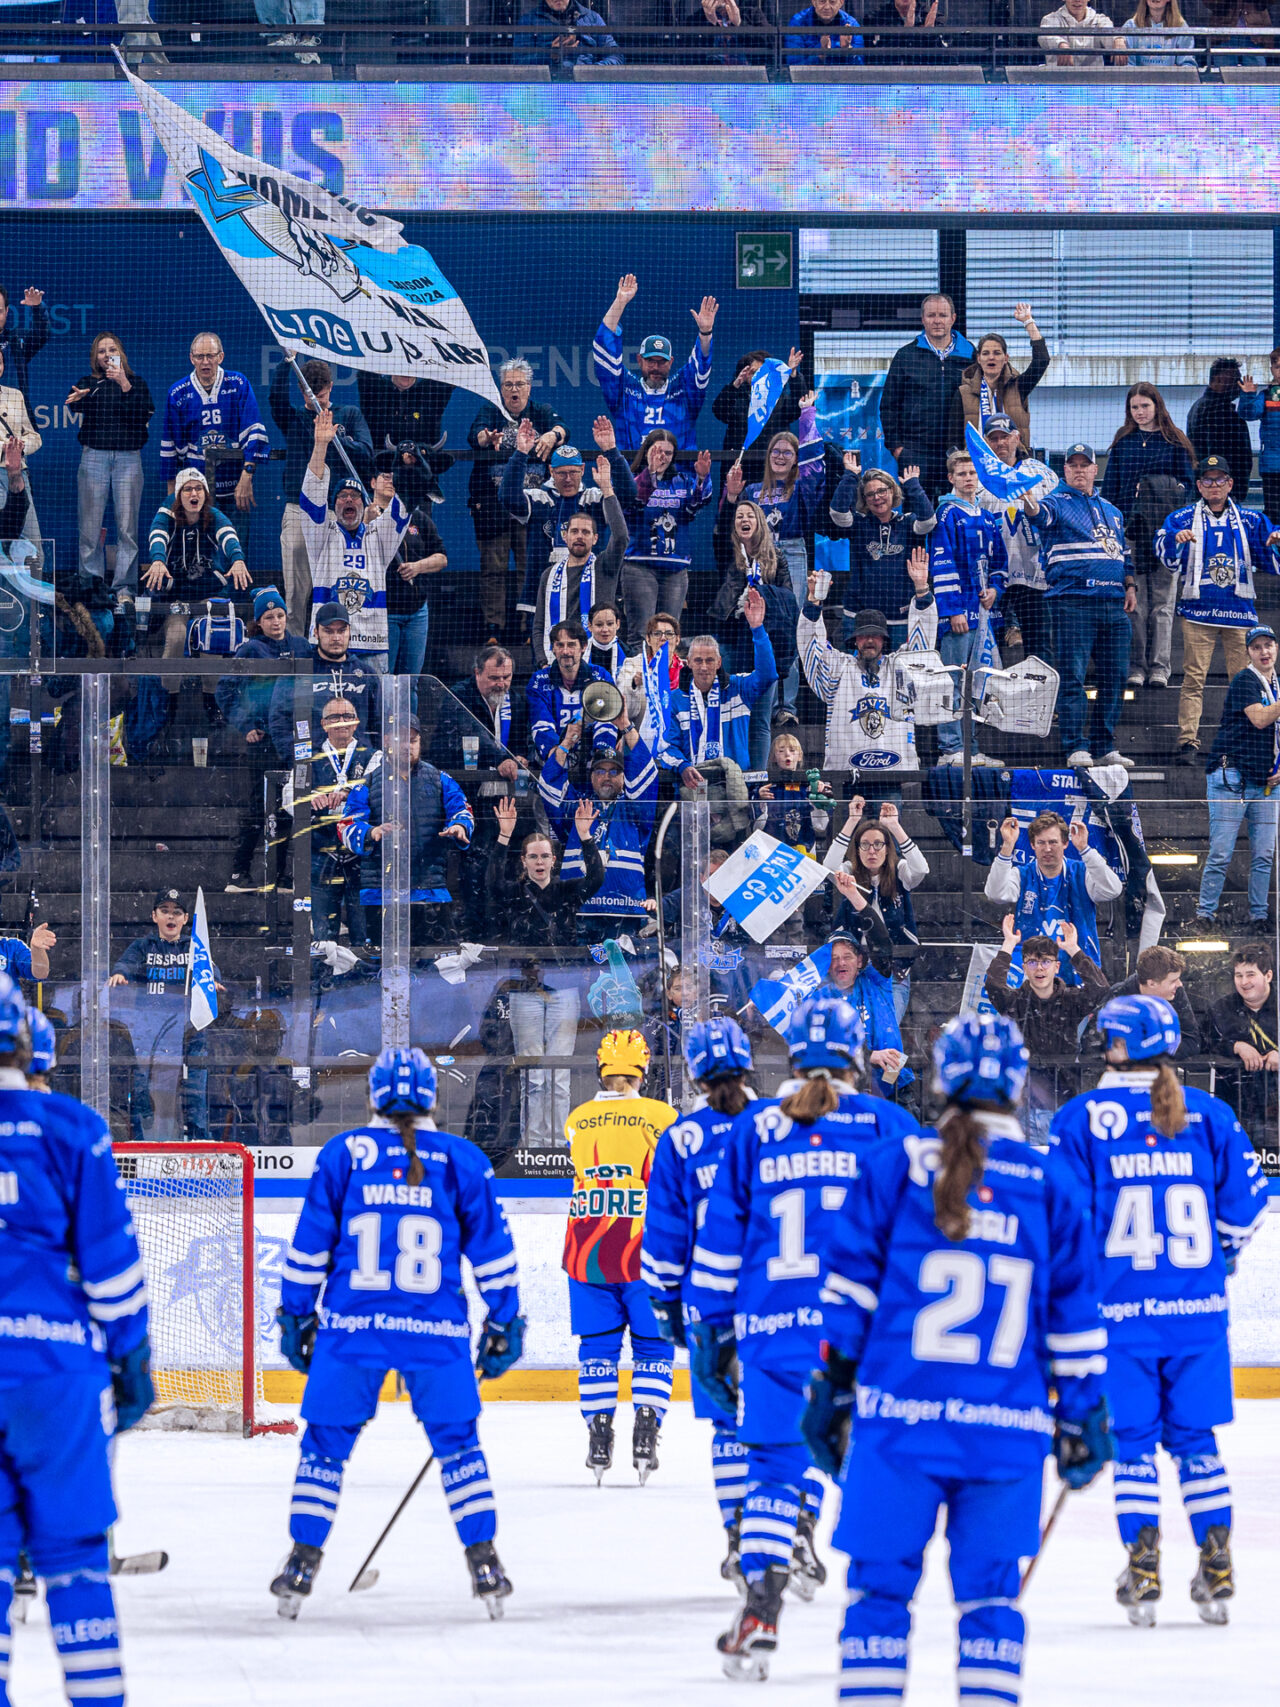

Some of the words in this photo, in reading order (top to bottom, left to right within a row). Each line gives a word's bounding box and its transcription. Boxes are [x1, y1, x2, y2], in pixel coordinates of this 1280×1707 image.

[201, 408, 222, 426] 26
[643, 406, 666, 425] 21
[201, 434, 227, 446] EVZ
[343, 553, 366, 570] 29
[1208, 553, 1234, 567] EVZ
[335, 578, 368, 592] EVZ
[857, 697, 888, 711] EVZ
[858, 751, 893, 768] Ford
[147, 982, 165, 995] UG
[524, 1168, 541, 1176] Swiss
[542, 1168, 565, 1177] Quality
[1110, 1151, 1194, 1179] WRANN
[362, 1182, 433, 1209] WASER
[1104, 1183, 1213, 1271] 49
[347, 1211, 443, 1295] 18
[911, 1248, 1035, 1369] 27
[330, 1311, 372, 1332] Zuger
[747, 1308, 794, 1335] Zuger
[879, 1392, 943, 1425] Zuger
